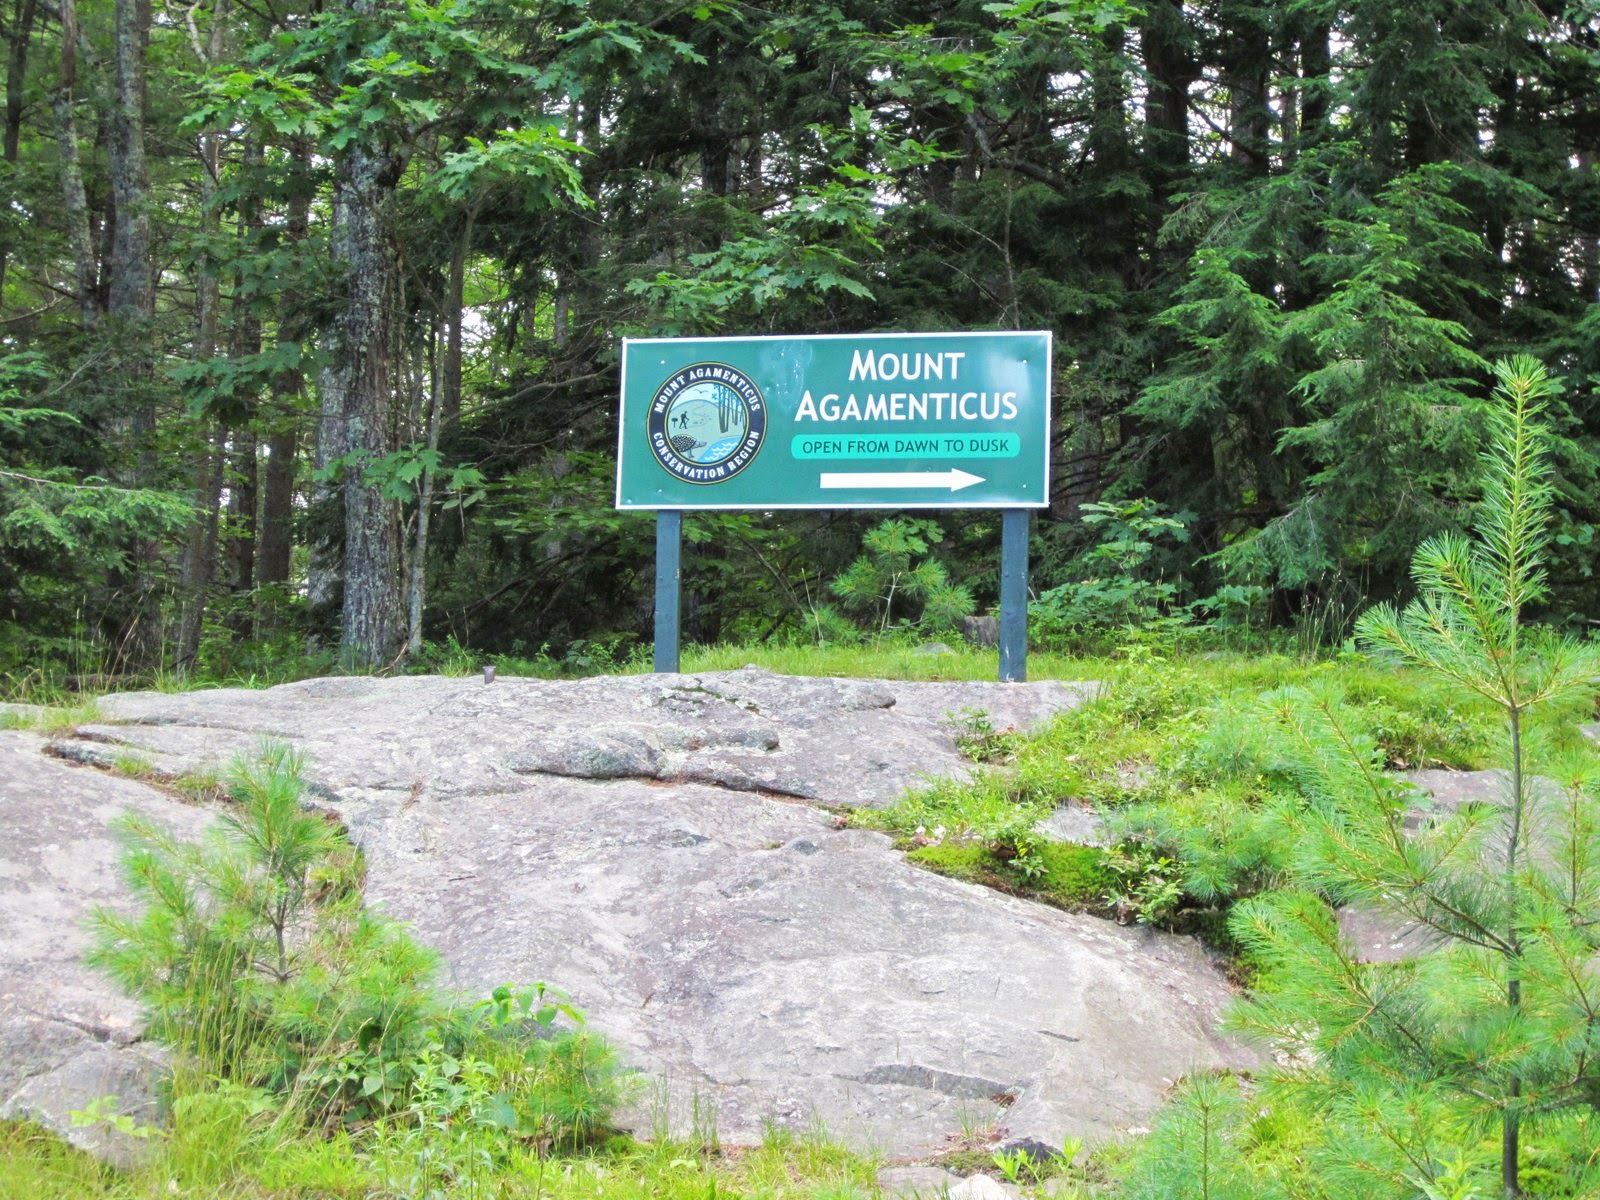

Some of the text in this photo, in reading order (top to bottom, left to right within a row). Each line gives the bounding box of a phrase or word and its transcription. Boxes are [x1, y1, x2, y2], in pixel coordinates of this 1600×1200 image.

[848, 349, 966, 381] MOUNT
[654, 367, 761, 413] MOUNT AGAMENTICUS
[794, 389, 1018, 422] AGAMENTICUS
[653, 430, 760, 479] CONSERVATION REGION
[802, 439, 1010, 454] OPEN FROM DAWN TO DUSK
